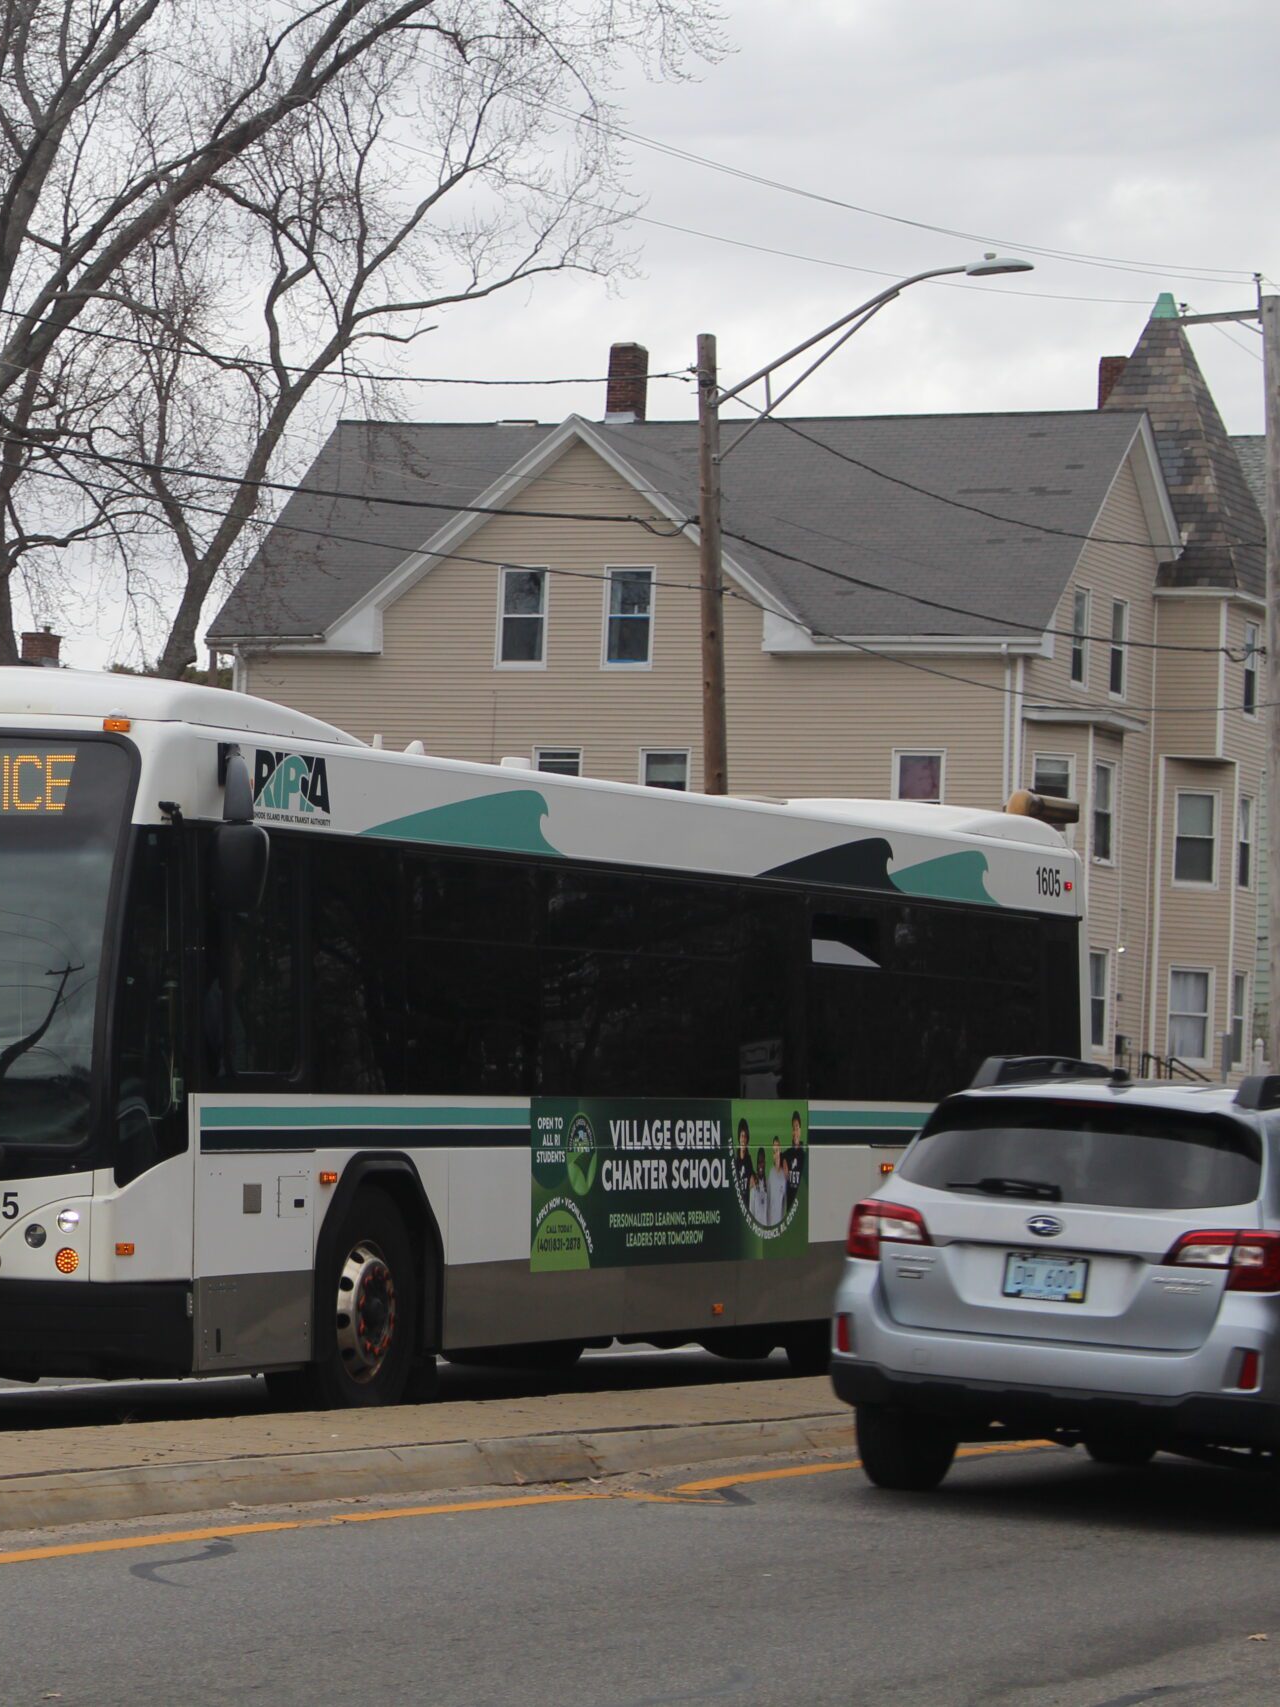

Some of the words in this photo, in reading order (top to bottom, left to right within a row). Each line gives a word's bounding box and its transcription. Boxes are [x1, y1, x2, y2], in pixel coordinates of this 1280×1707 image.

[280, 814, 295, 824] PUBLIC
[294, 815, 310, 825] TRANSIT
[1036, 866, 1061, 898] 1605
[537, 1116, 554, 1130] OPEN
[554, 1116, 564, 1130] TO
[542, 1133, 554, 1147] ALL
[554, 1133, 561, 1146] RI
[609, 1119, 671, 1151] VILLAGE
[674, 1119, 721, 1150] GREEN
[536, 1150, 566, 1164] STUDENTS
[601, 1159, 668, 1191] CHARTER
[671, 1157, 729, 1189] SCHOOL
[536, 1202, 549, 1228] APPLY
[548, 1196, 561, 1211] NOW
[609, 1212, 655, 1229] PERSONALIZED
[655, 1210, 687, 1227] LEARNING,
[687, 1209, 721, 1225] PREPARING
[545, 1224, 558, 1234] CALL
[626, 1232, 653, 1247] LEADERS
[653, 1231, 667, 1246] FOR
[667, 1229, 704, 1246] TOMORROW
